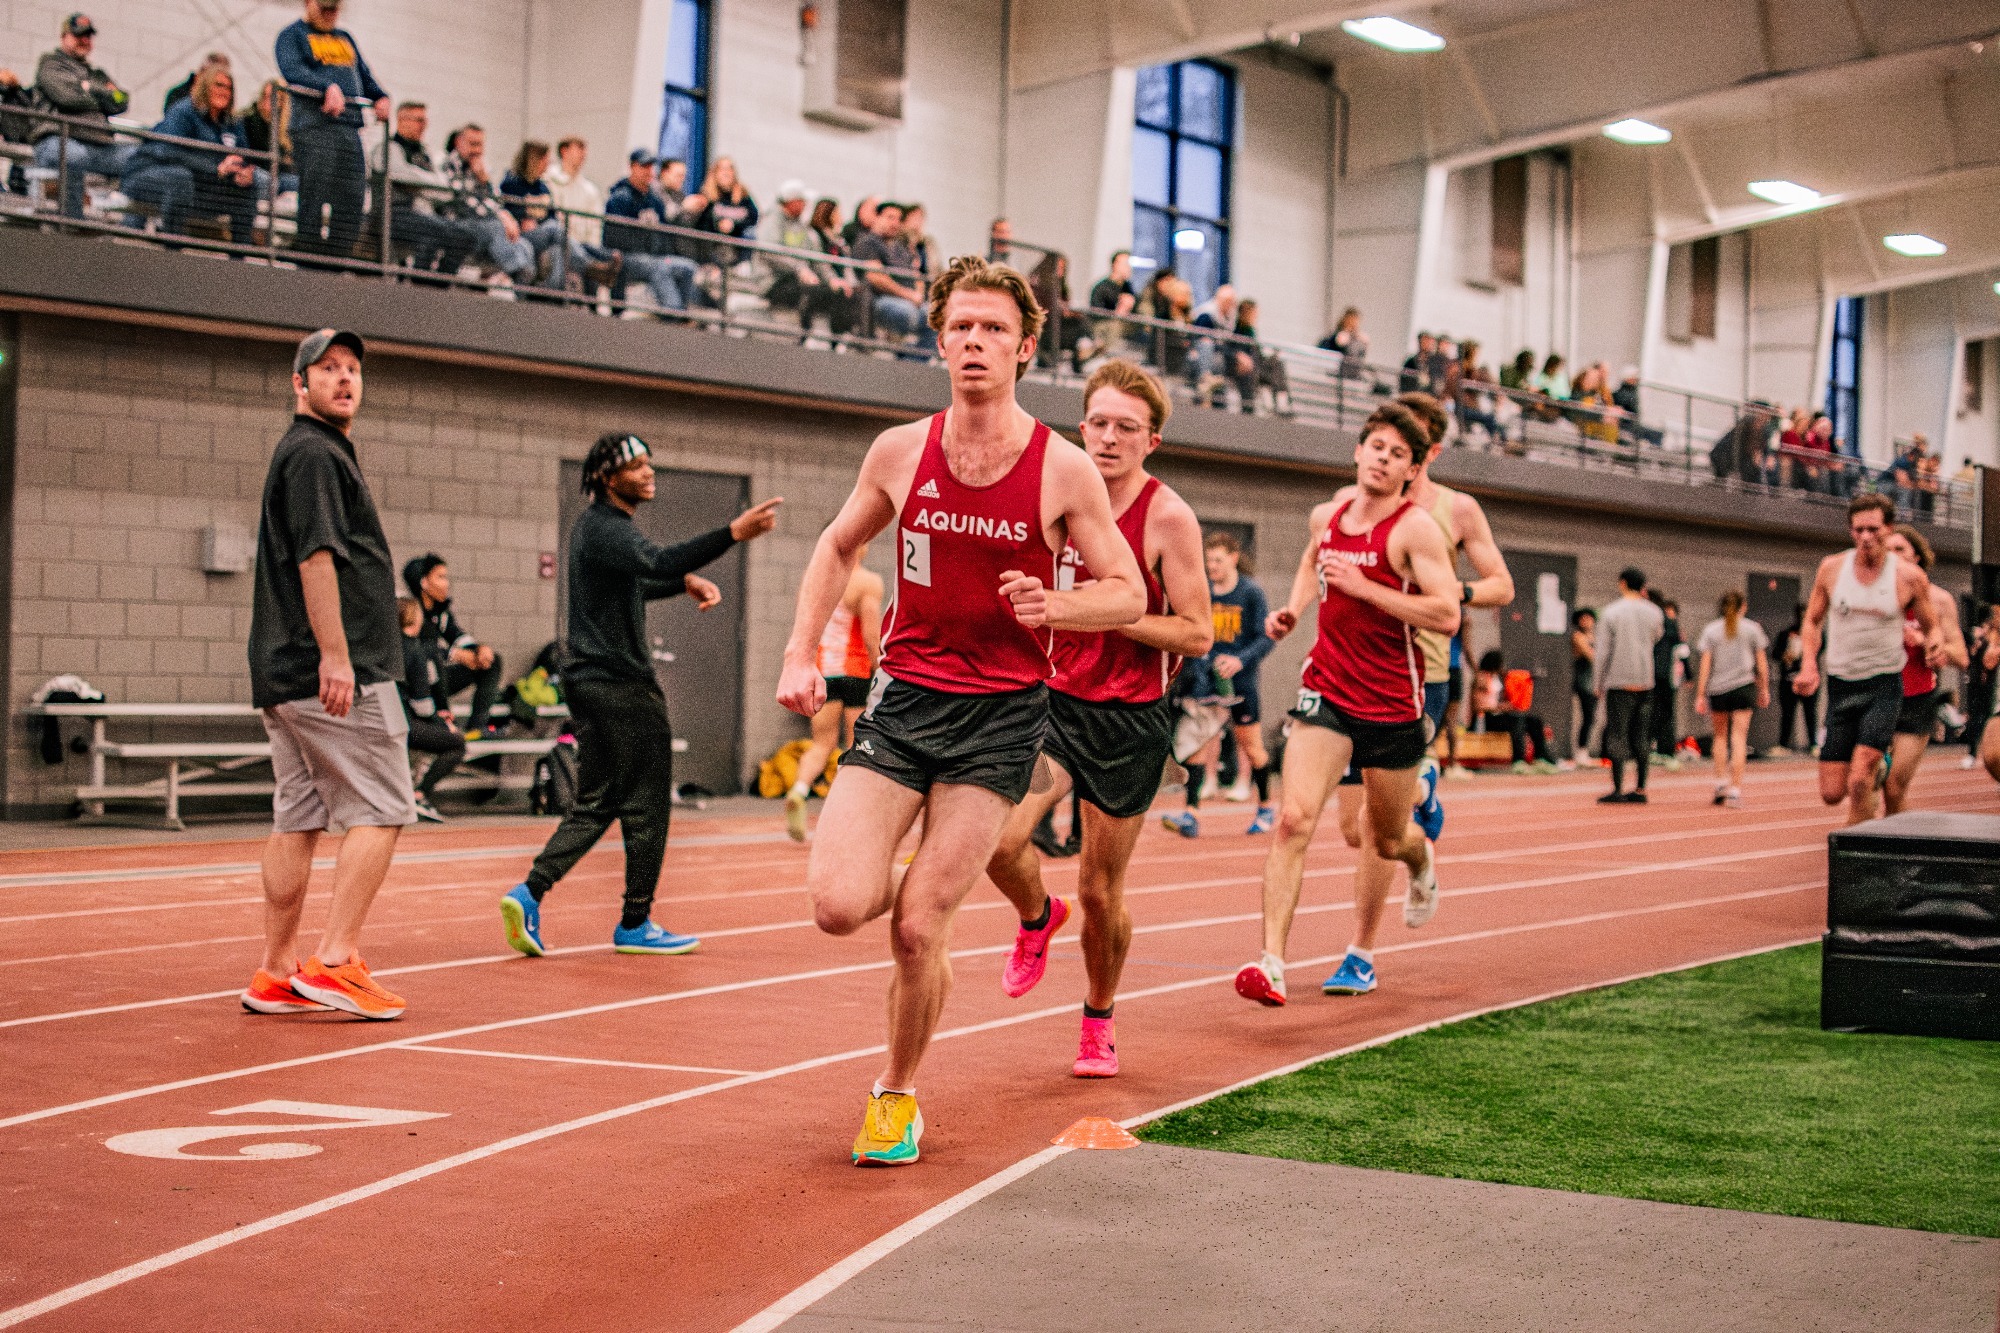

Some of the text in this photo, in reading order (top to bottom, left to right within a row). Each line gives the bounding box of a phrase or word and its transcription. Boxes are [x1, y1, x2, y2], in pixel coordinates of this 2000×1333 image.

[917, 488, 940, 499] adidas
[913, 508, 1028, 542] AQUINAS
[906, 539, 918, 572] 2
[105, 1099, 452, 1161] 2
